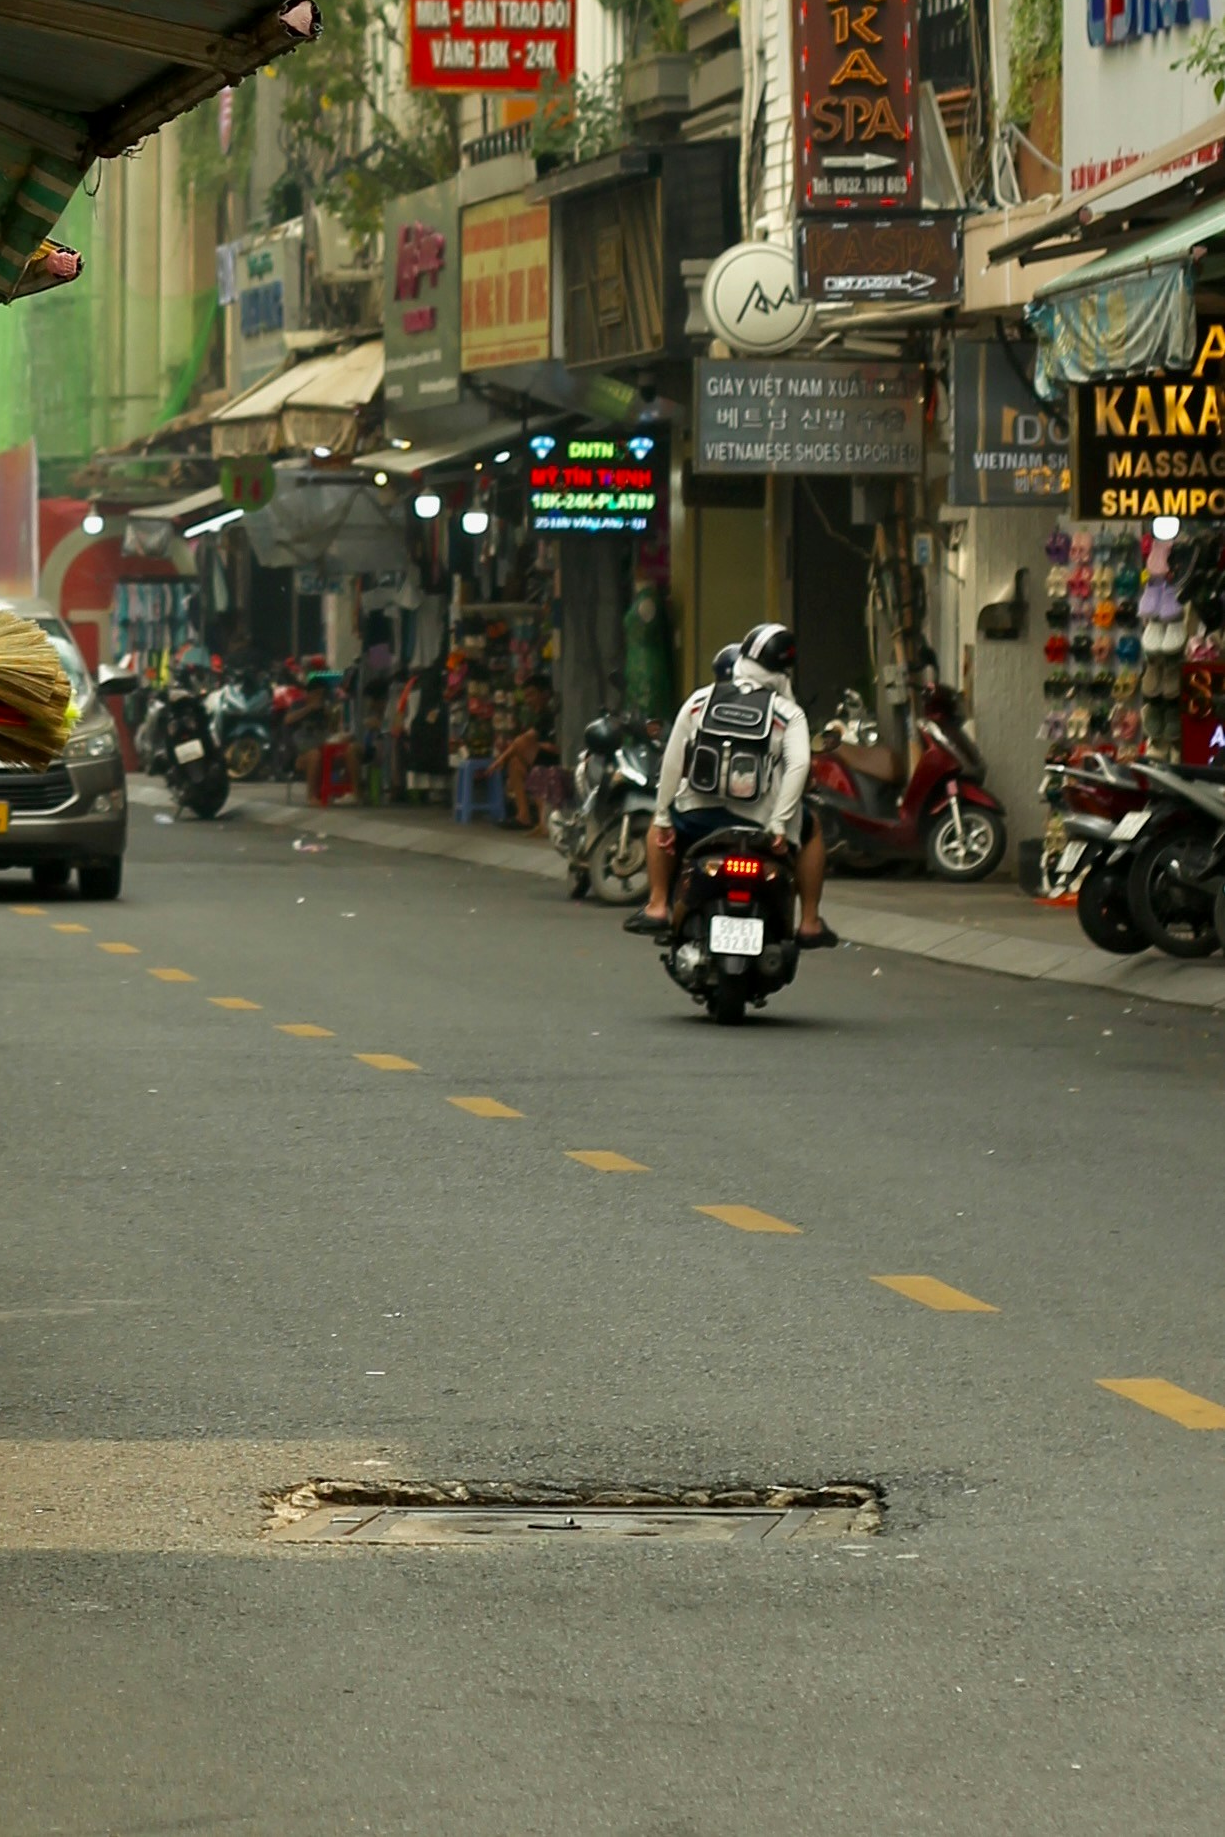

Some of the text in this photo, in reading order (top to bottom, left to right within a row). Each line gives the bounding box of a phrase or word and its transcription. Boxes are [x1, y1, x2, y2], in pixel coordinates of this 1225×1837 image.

[415, 0, 450, 29] MUA
[499, 0, 540, 29] TRAO
[430, 34, 476, 68] VÀNG
[478, 41, 511, 68] 18K
[525, 40, 557, 69] 24K
[812, 95, 907, 143] SPA
[788, 378, 823, 397] NAM
[1094, 385, 1222, 436] KAKA
[705, 443, 792, 462] VIETNAMESE
[796, 443, 842, 462] SHOES
[973, 452, 1043, 470] VIETNAM
